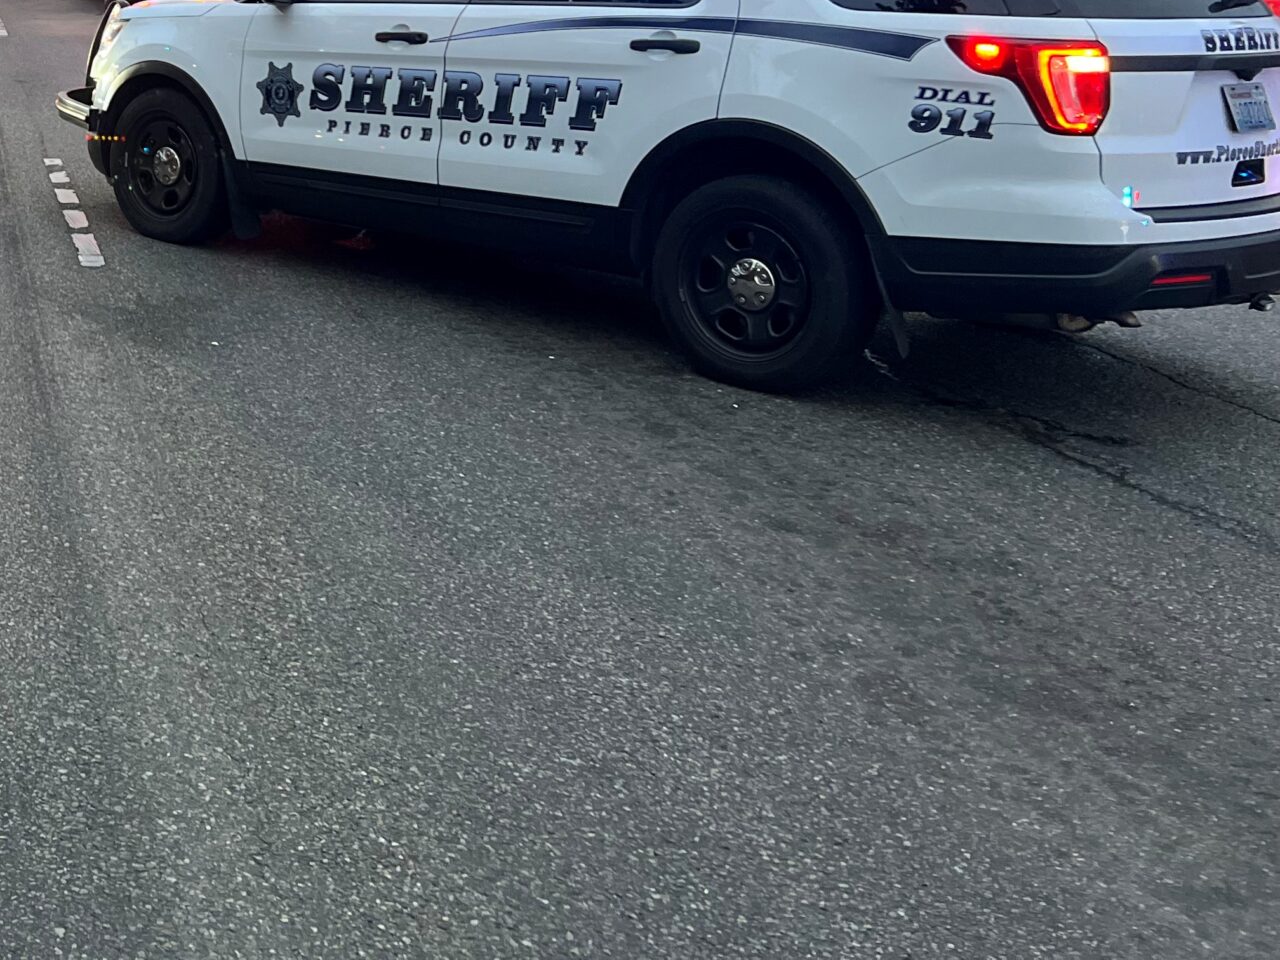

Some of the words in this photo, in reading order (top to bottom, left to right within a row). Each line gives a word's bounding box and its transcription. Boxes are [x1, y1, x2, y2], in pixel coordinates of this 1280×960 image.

[309, 63, 623, 131] SHERIFF
[914, 86, 996, 107] DIAL
[326, 119, 433, 142] PIERCE
[459, 130, 588, 156] COUNTY
[908, 103, 996, 140] 911
